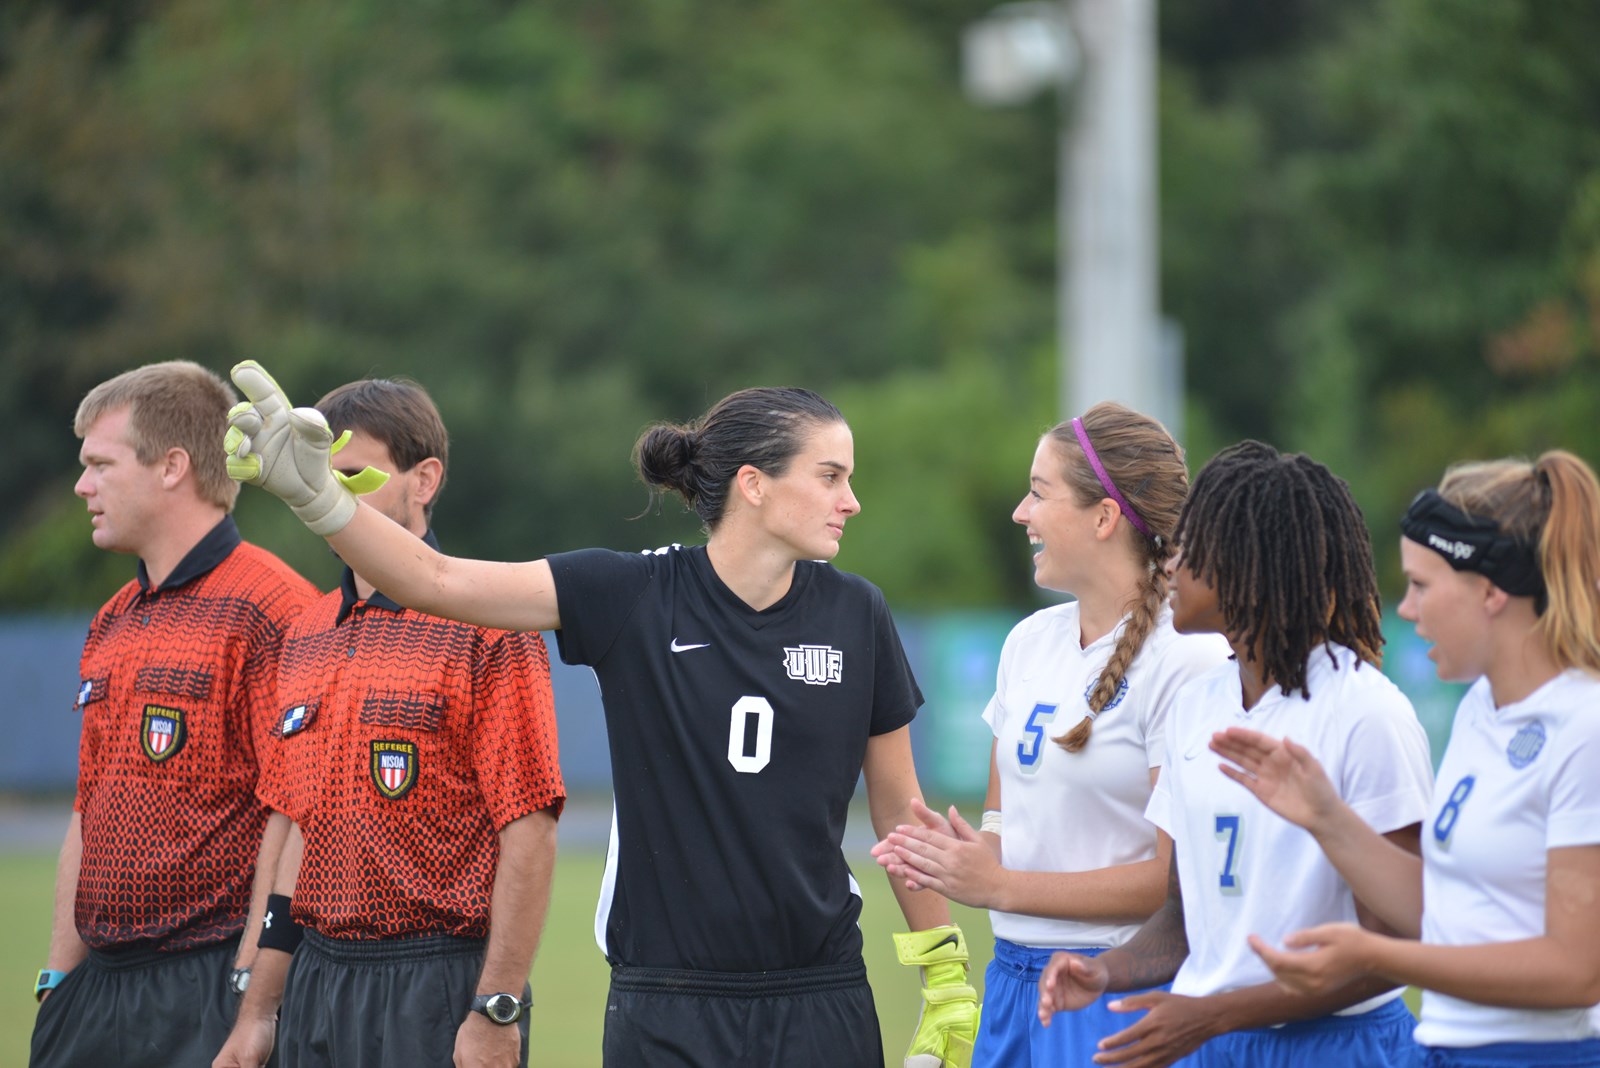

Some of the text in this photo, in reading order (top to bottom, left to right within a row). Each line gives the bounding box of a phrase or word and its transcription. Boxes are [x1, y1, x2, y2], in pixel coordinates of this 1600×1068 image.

[783, 644, 843, 686] UWF
[146, 705, 180, 721] REFEREE
[373, 742, 413, 755] REFEREE
[1017, 703, 1057, 768] 5
[381, 755, 405, 769] NISOA
[1434, 774, 1475, 843] 8
[1215, 815, 1241, 890] 7
